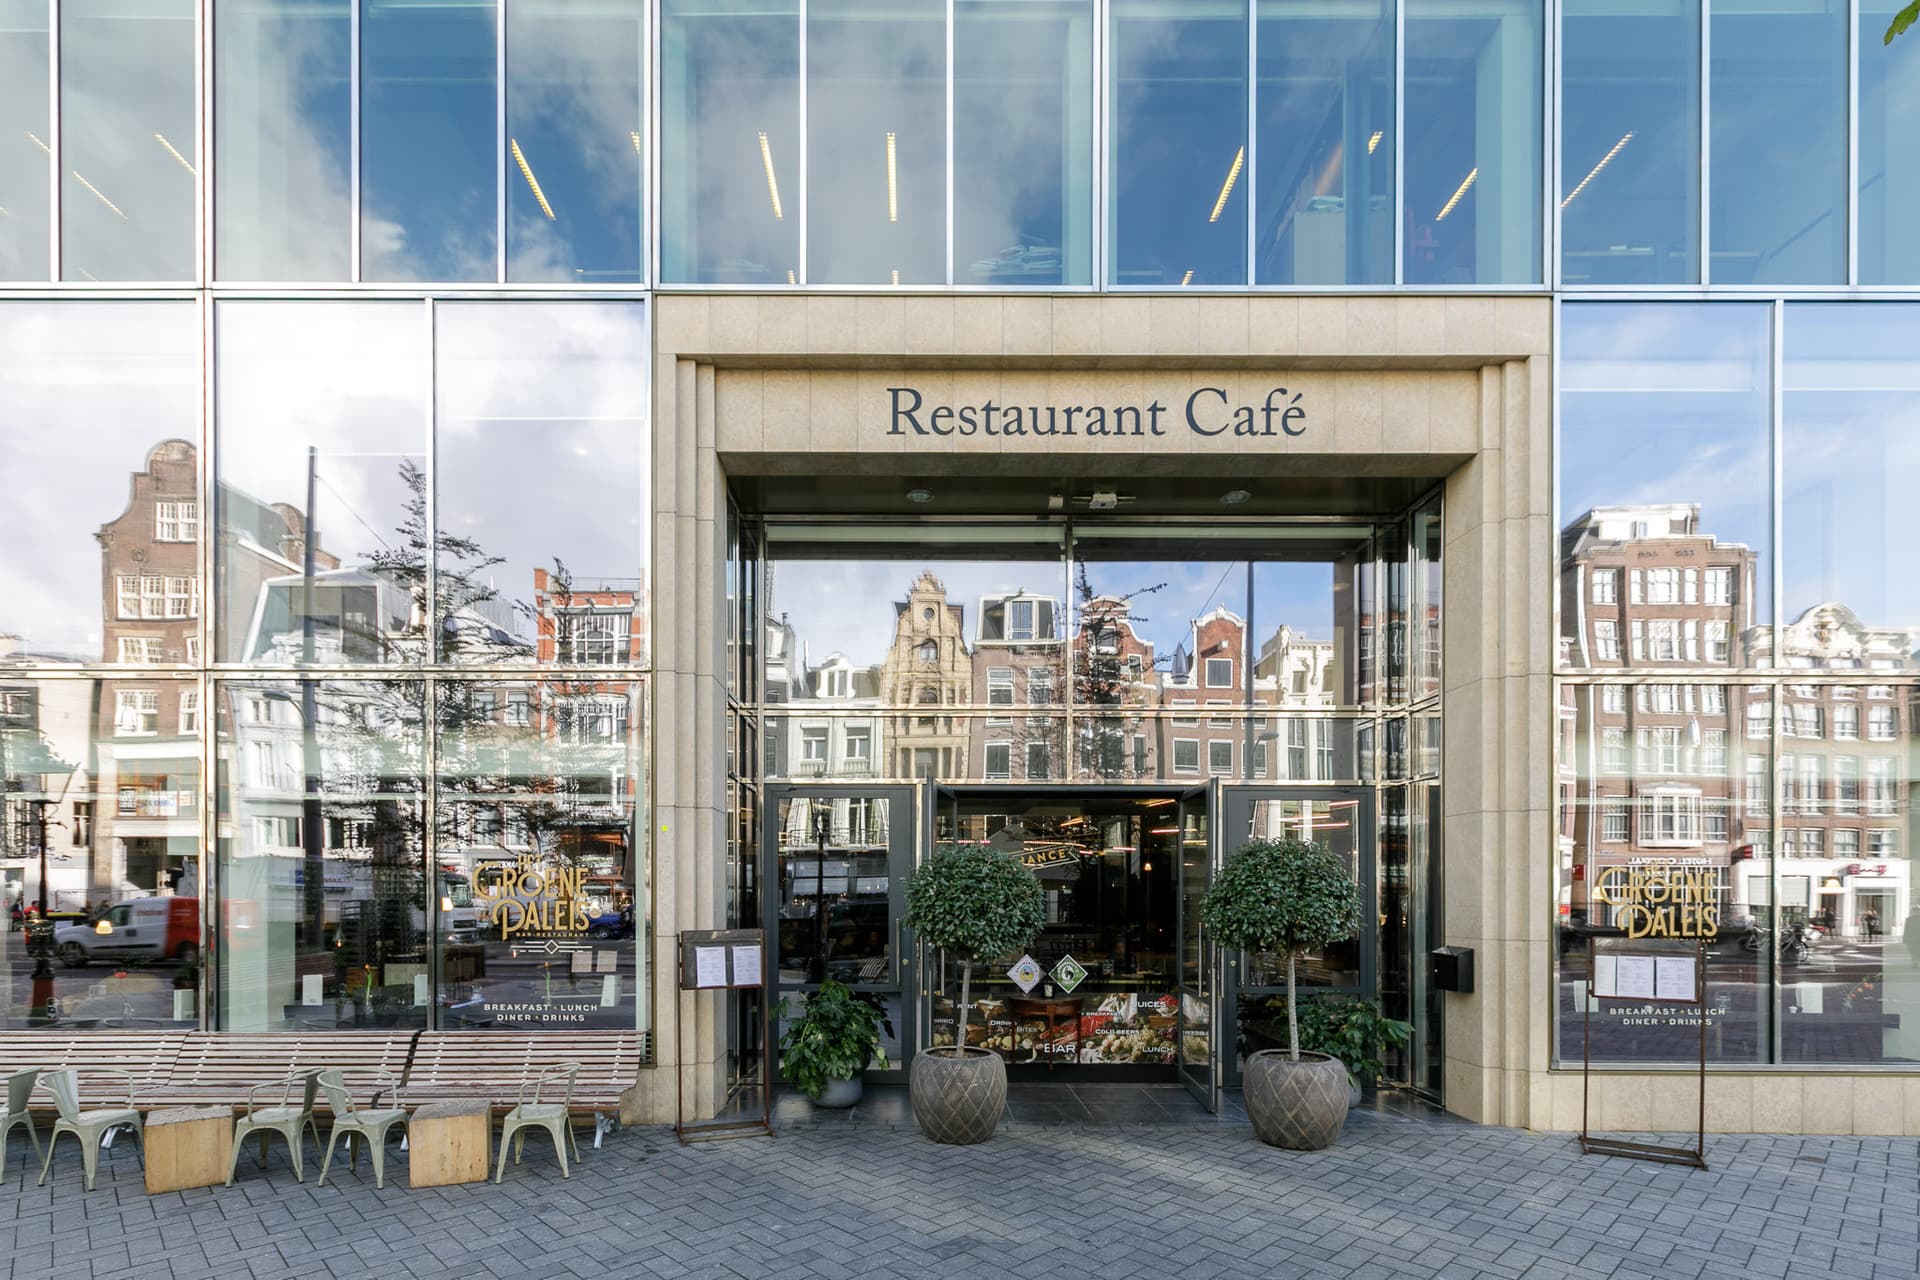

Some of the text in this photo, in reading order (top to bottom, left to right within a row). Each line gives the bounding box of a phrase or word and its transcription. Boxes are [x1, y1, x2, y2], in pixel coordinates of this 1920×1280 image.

[886, 387, 1307, 436] Restaurant Café
[472, 861, 590, 900] GROENE
[1598, 866, 1718, 906] GROENE
[492, 899, 590, 941] PALEIS
[1617, 904, 1718, 940] PALEIS
[483, 1003, 598, 1012] BREAKFAST LUNCH
[496, 1013, 585, 1022] DINER DRINKS
[1609, 1007, 1677, 1015] BREAKFAST
